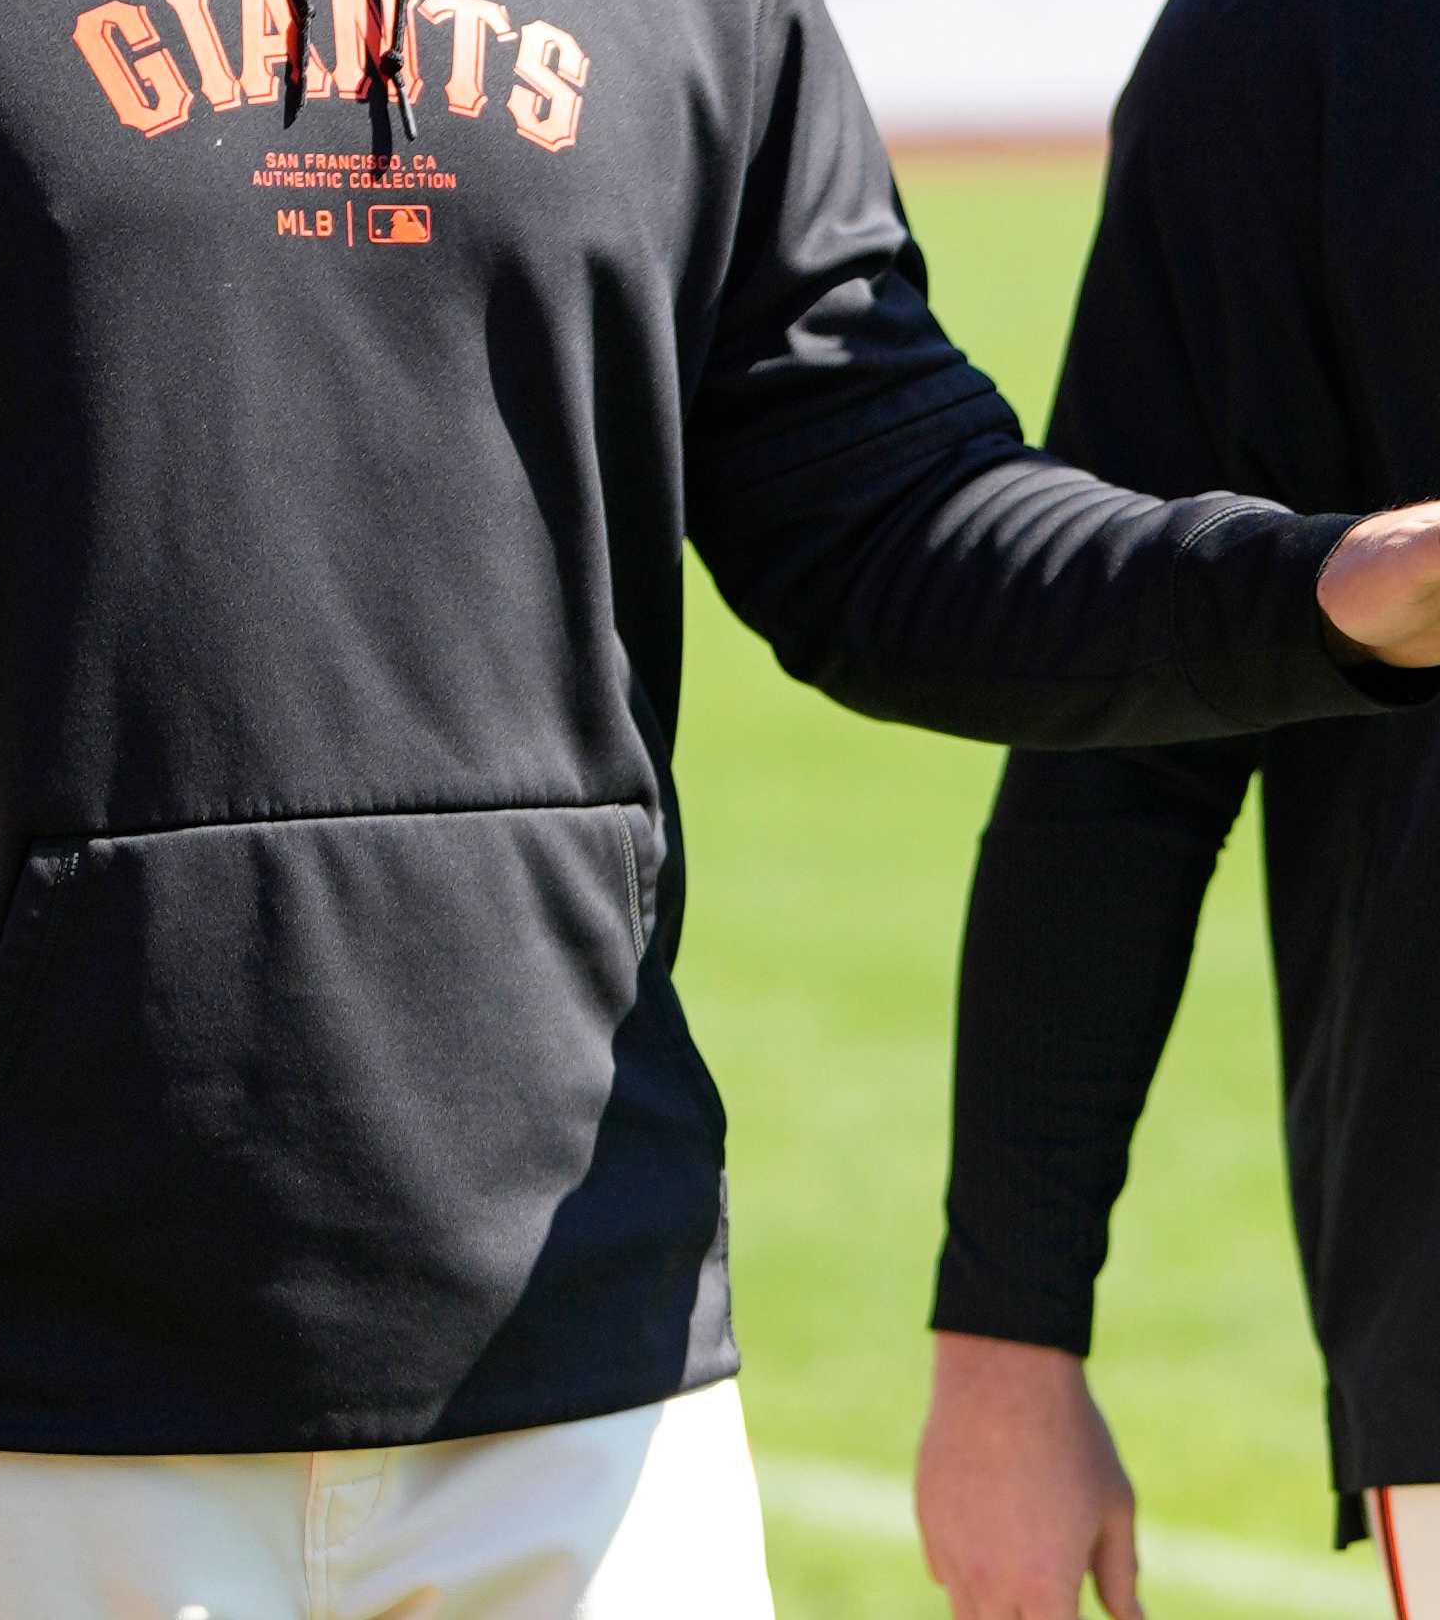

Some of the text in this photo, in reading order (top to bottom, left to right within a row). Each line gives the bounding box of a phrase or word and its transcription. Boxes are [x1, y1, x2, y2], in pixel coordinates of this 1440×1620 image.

[264, 152, 300, 170] SAN
[411, 154, 438, 171] CA
[252, 170, 457, 190] AUTHENTIC COLLECTION
[276, 208, 335, 237] MLB
